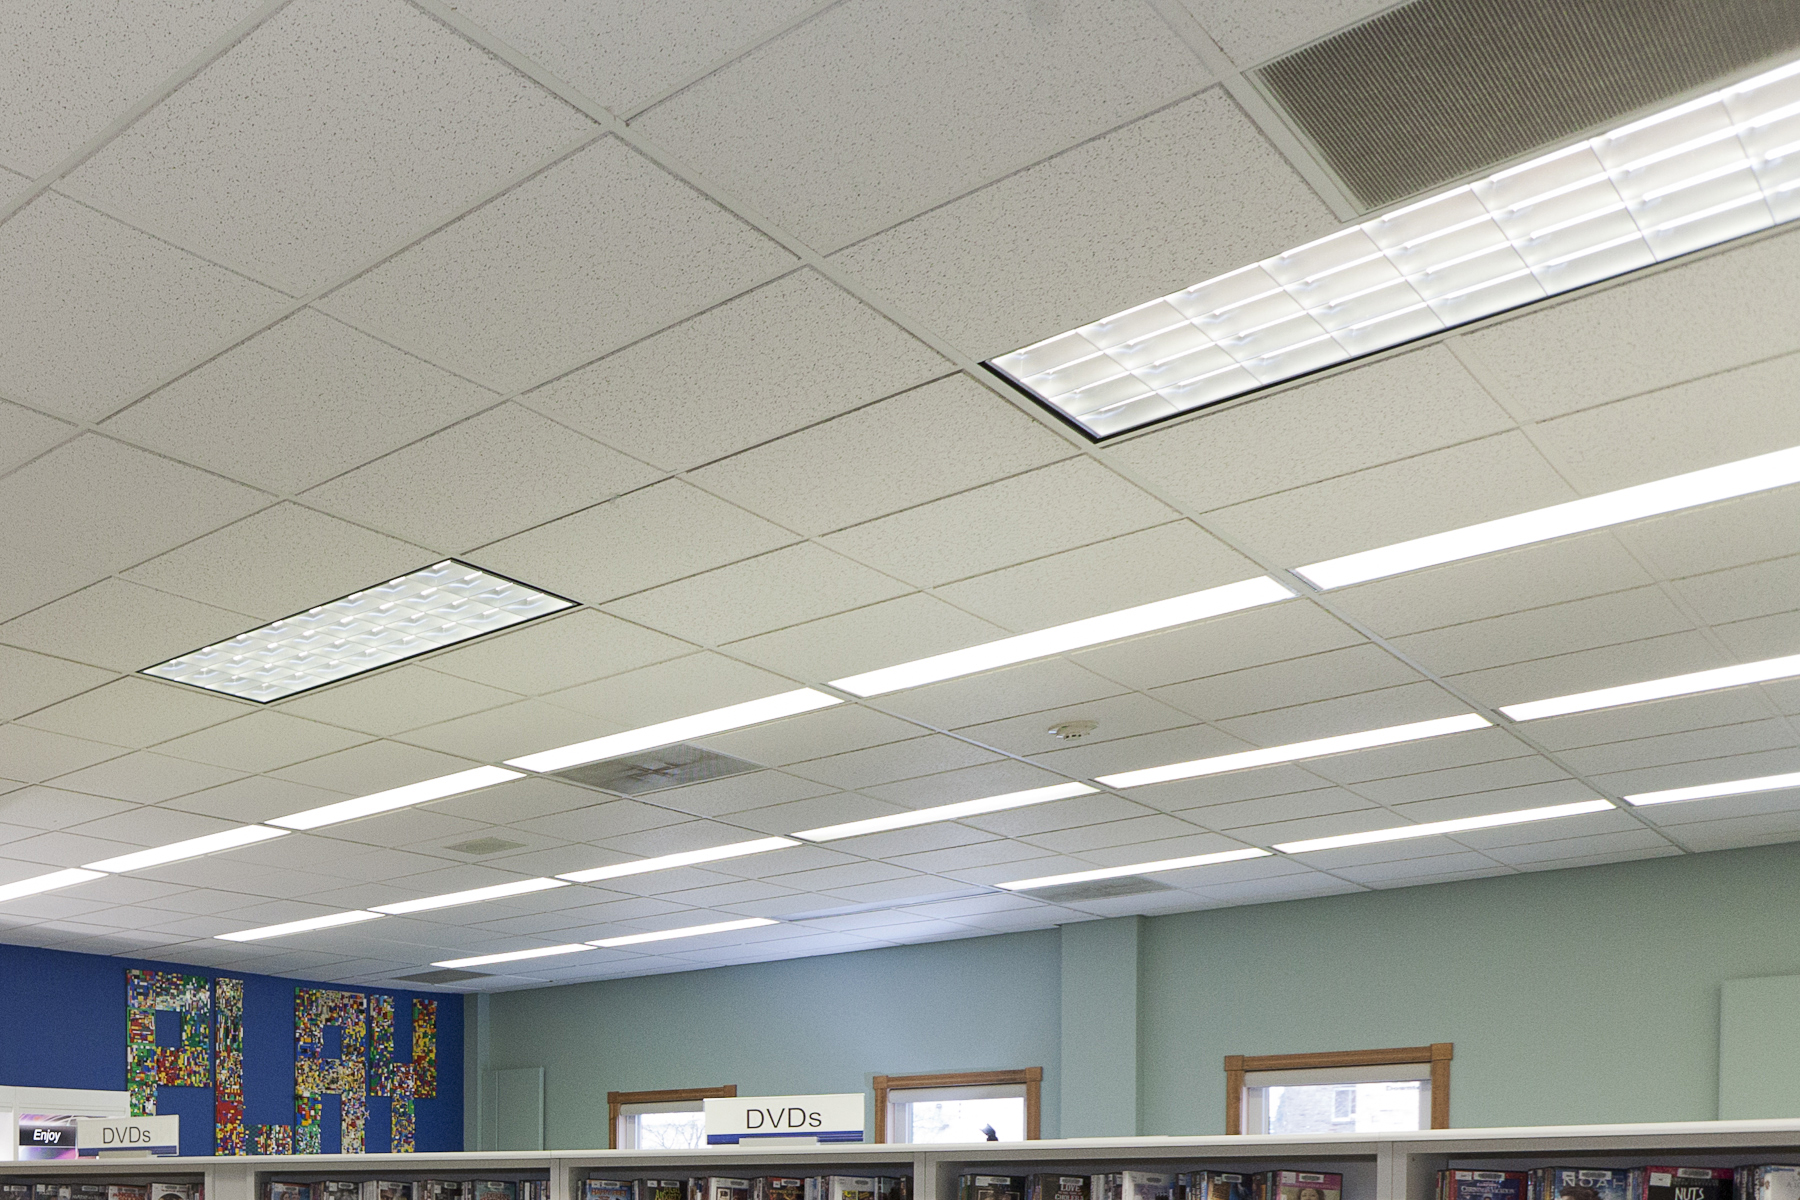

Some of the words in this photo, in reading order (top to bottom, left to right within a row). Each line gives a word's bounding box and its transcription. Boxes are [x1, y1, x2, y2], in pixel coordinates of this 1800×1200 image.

[126, 968, 437, 1156] PLAY
[746, 1107, 822, 1129] DVDs
[33, 1129, 61, 1143] Enjoy
[102, 1126, 151, 1144] DVDs
